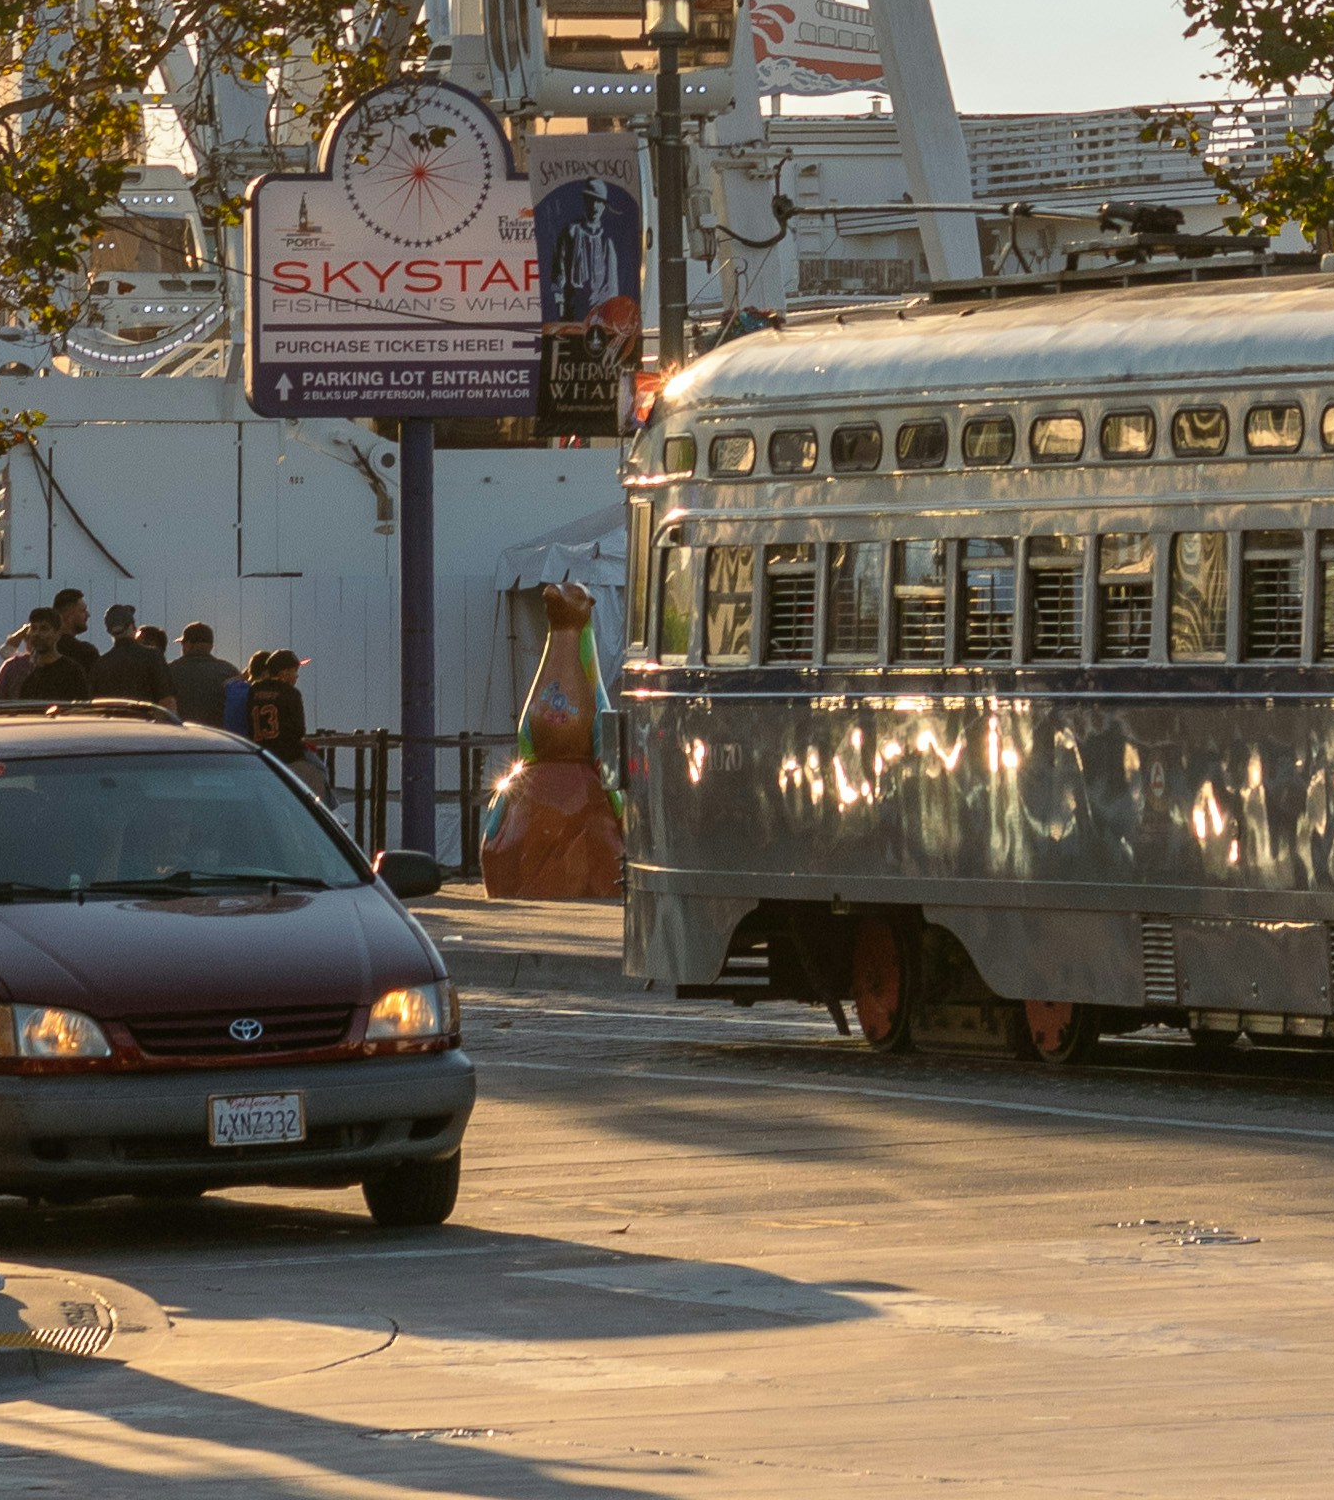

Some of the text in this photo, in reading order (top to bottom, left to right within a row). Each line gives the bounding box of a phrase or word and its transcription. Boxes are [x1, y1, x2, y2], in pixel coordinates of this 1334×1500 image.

[539, 158, 633, 186] SAN FRANCISCO
[286, 237, 320, 248] PORT
[272, 297, 456, 313] FISHERMAN'S
[274, 338, 504, 354] PURCHASE TICKETS HERE!
[302, 369, 531, 386] PARKING LOT ENTRANCE
[303, 391, 311, 400] 2
[311, 390, 342, 400] BLKS
[342, 390, 357, 400] UP
[430, 389, 466, 399] RIGHT
[466, 389, 483, 399] ON
[485, 388, 530, 399] TAYLOR
[251, 704, 280, 742] 13
[217, 1109, 298, 1137] 4XNZ332
